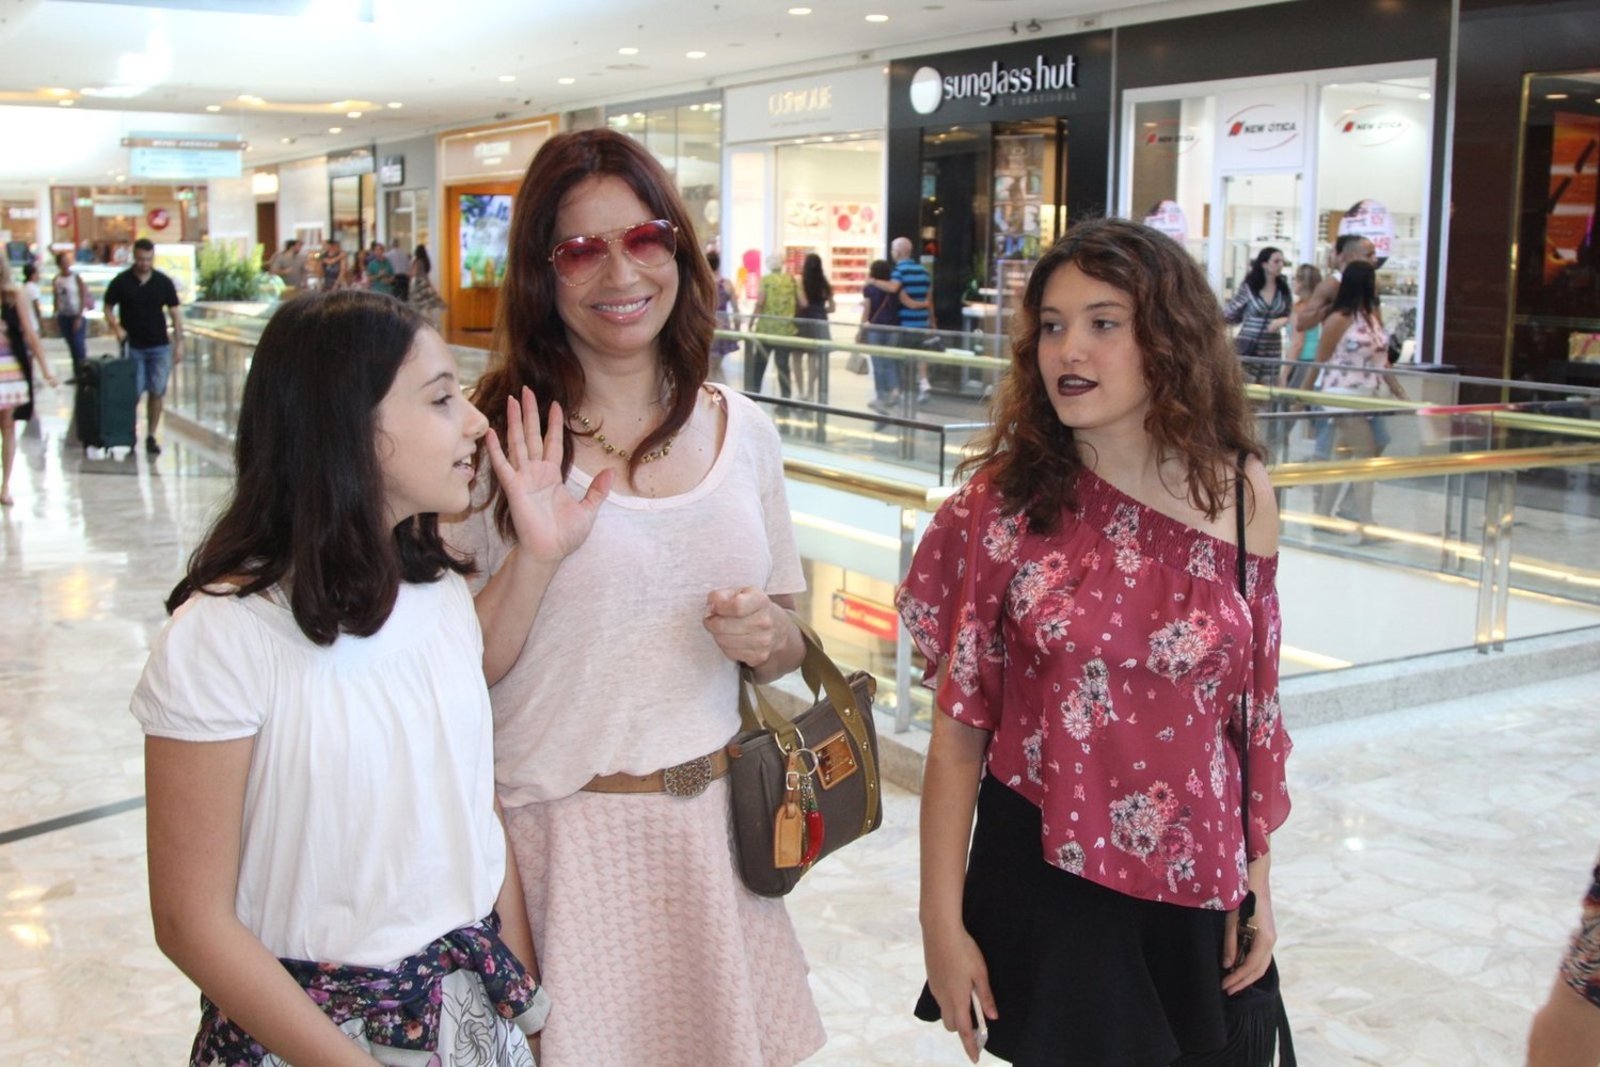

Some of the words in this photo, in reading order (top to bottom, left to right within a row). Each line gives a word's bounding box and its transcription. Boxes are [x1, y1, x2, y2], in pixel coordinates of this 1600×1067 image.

[943, 60, 1032, 106] sunglass
[1036, 54, 1076, 90] hut
[1244, 124, 1264, 133] NEW
